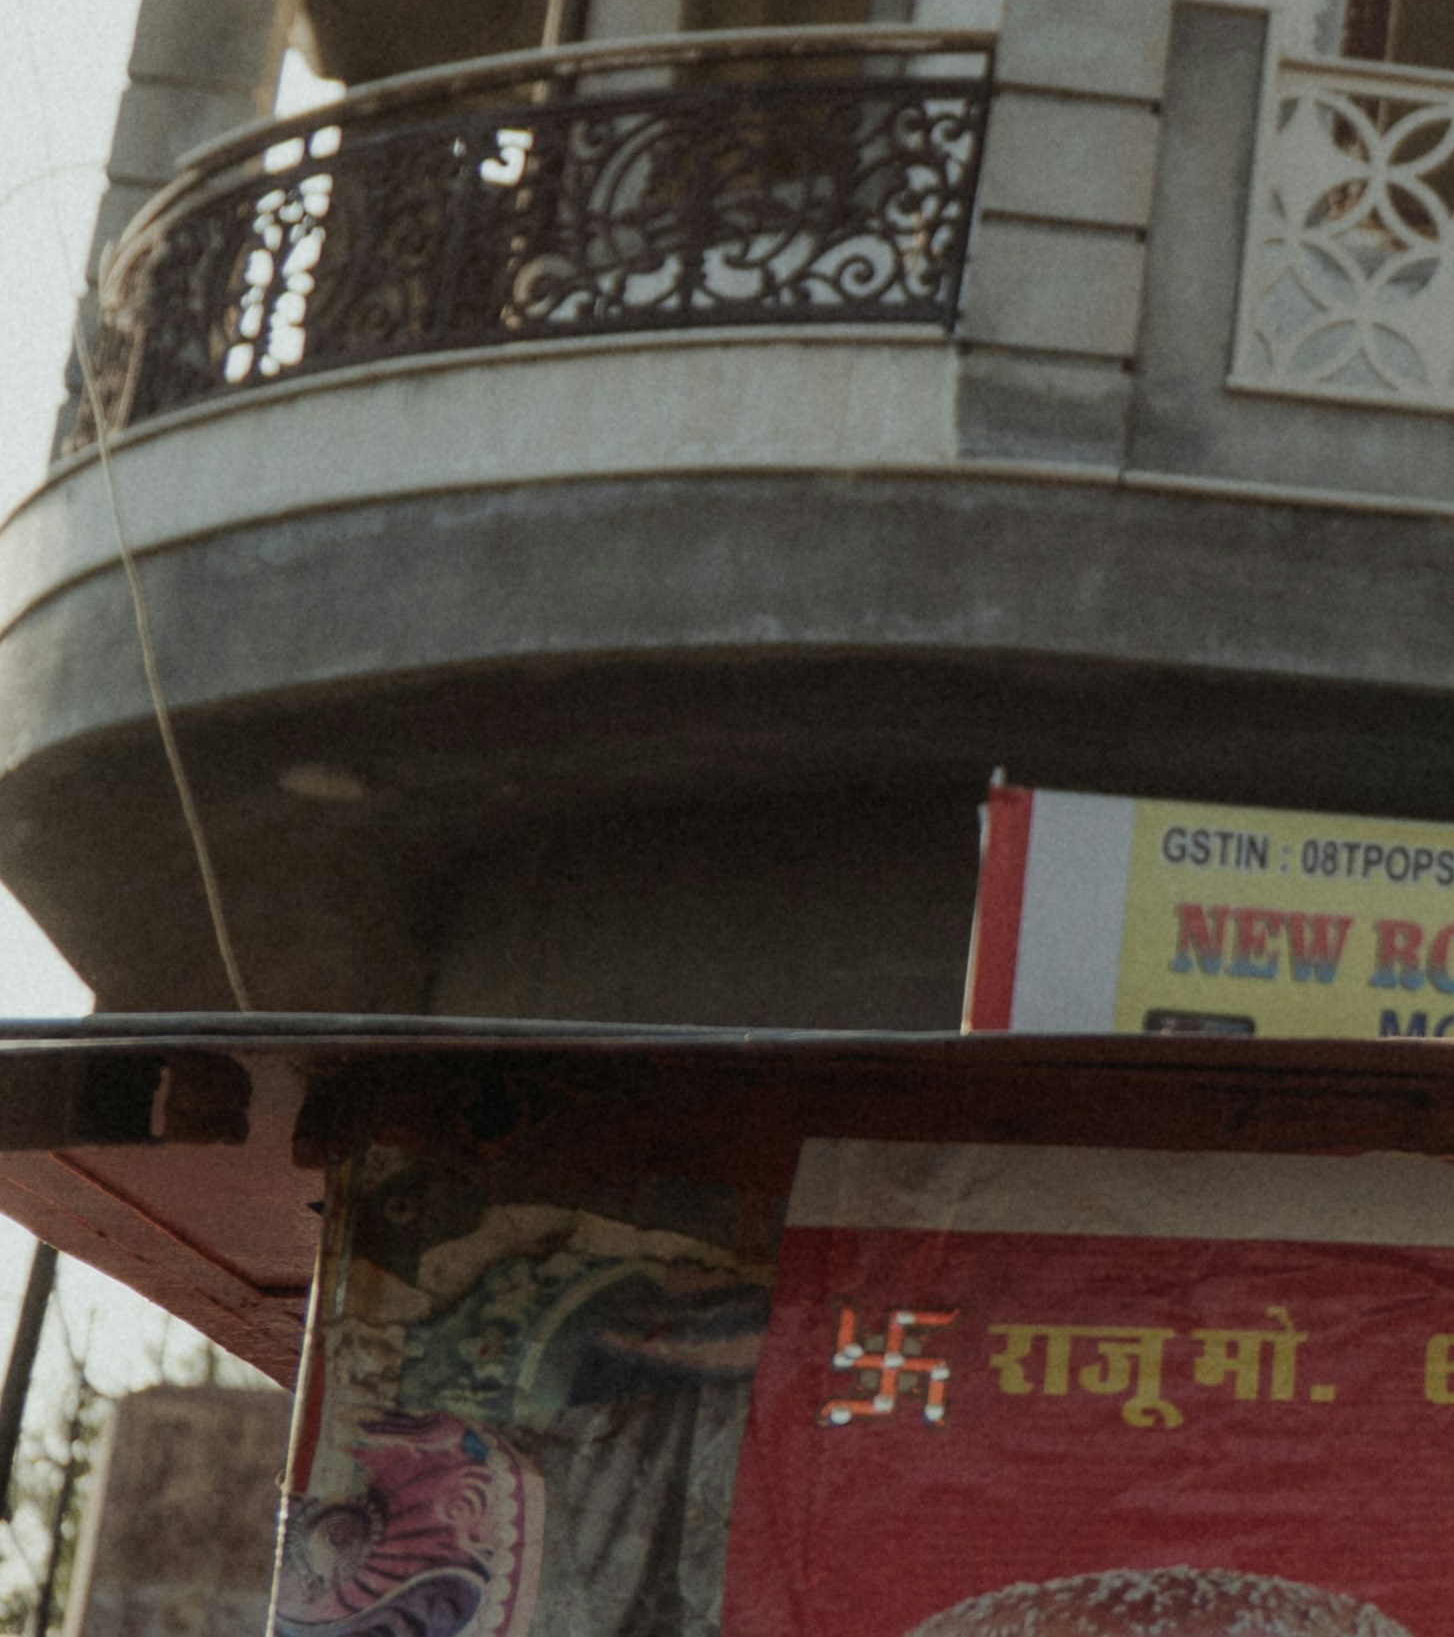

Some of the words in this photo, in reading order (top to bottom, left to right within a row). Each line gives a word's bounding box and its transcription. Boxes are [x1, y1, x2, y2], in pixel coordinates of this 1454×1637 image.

[1162, 826, 1269, 868] GSTIN
[1170, 902, 1354, 984] NEW
[986, 1323, 1185, 1429] राजू
[1190, 1305, 1338, 1404] मो.
